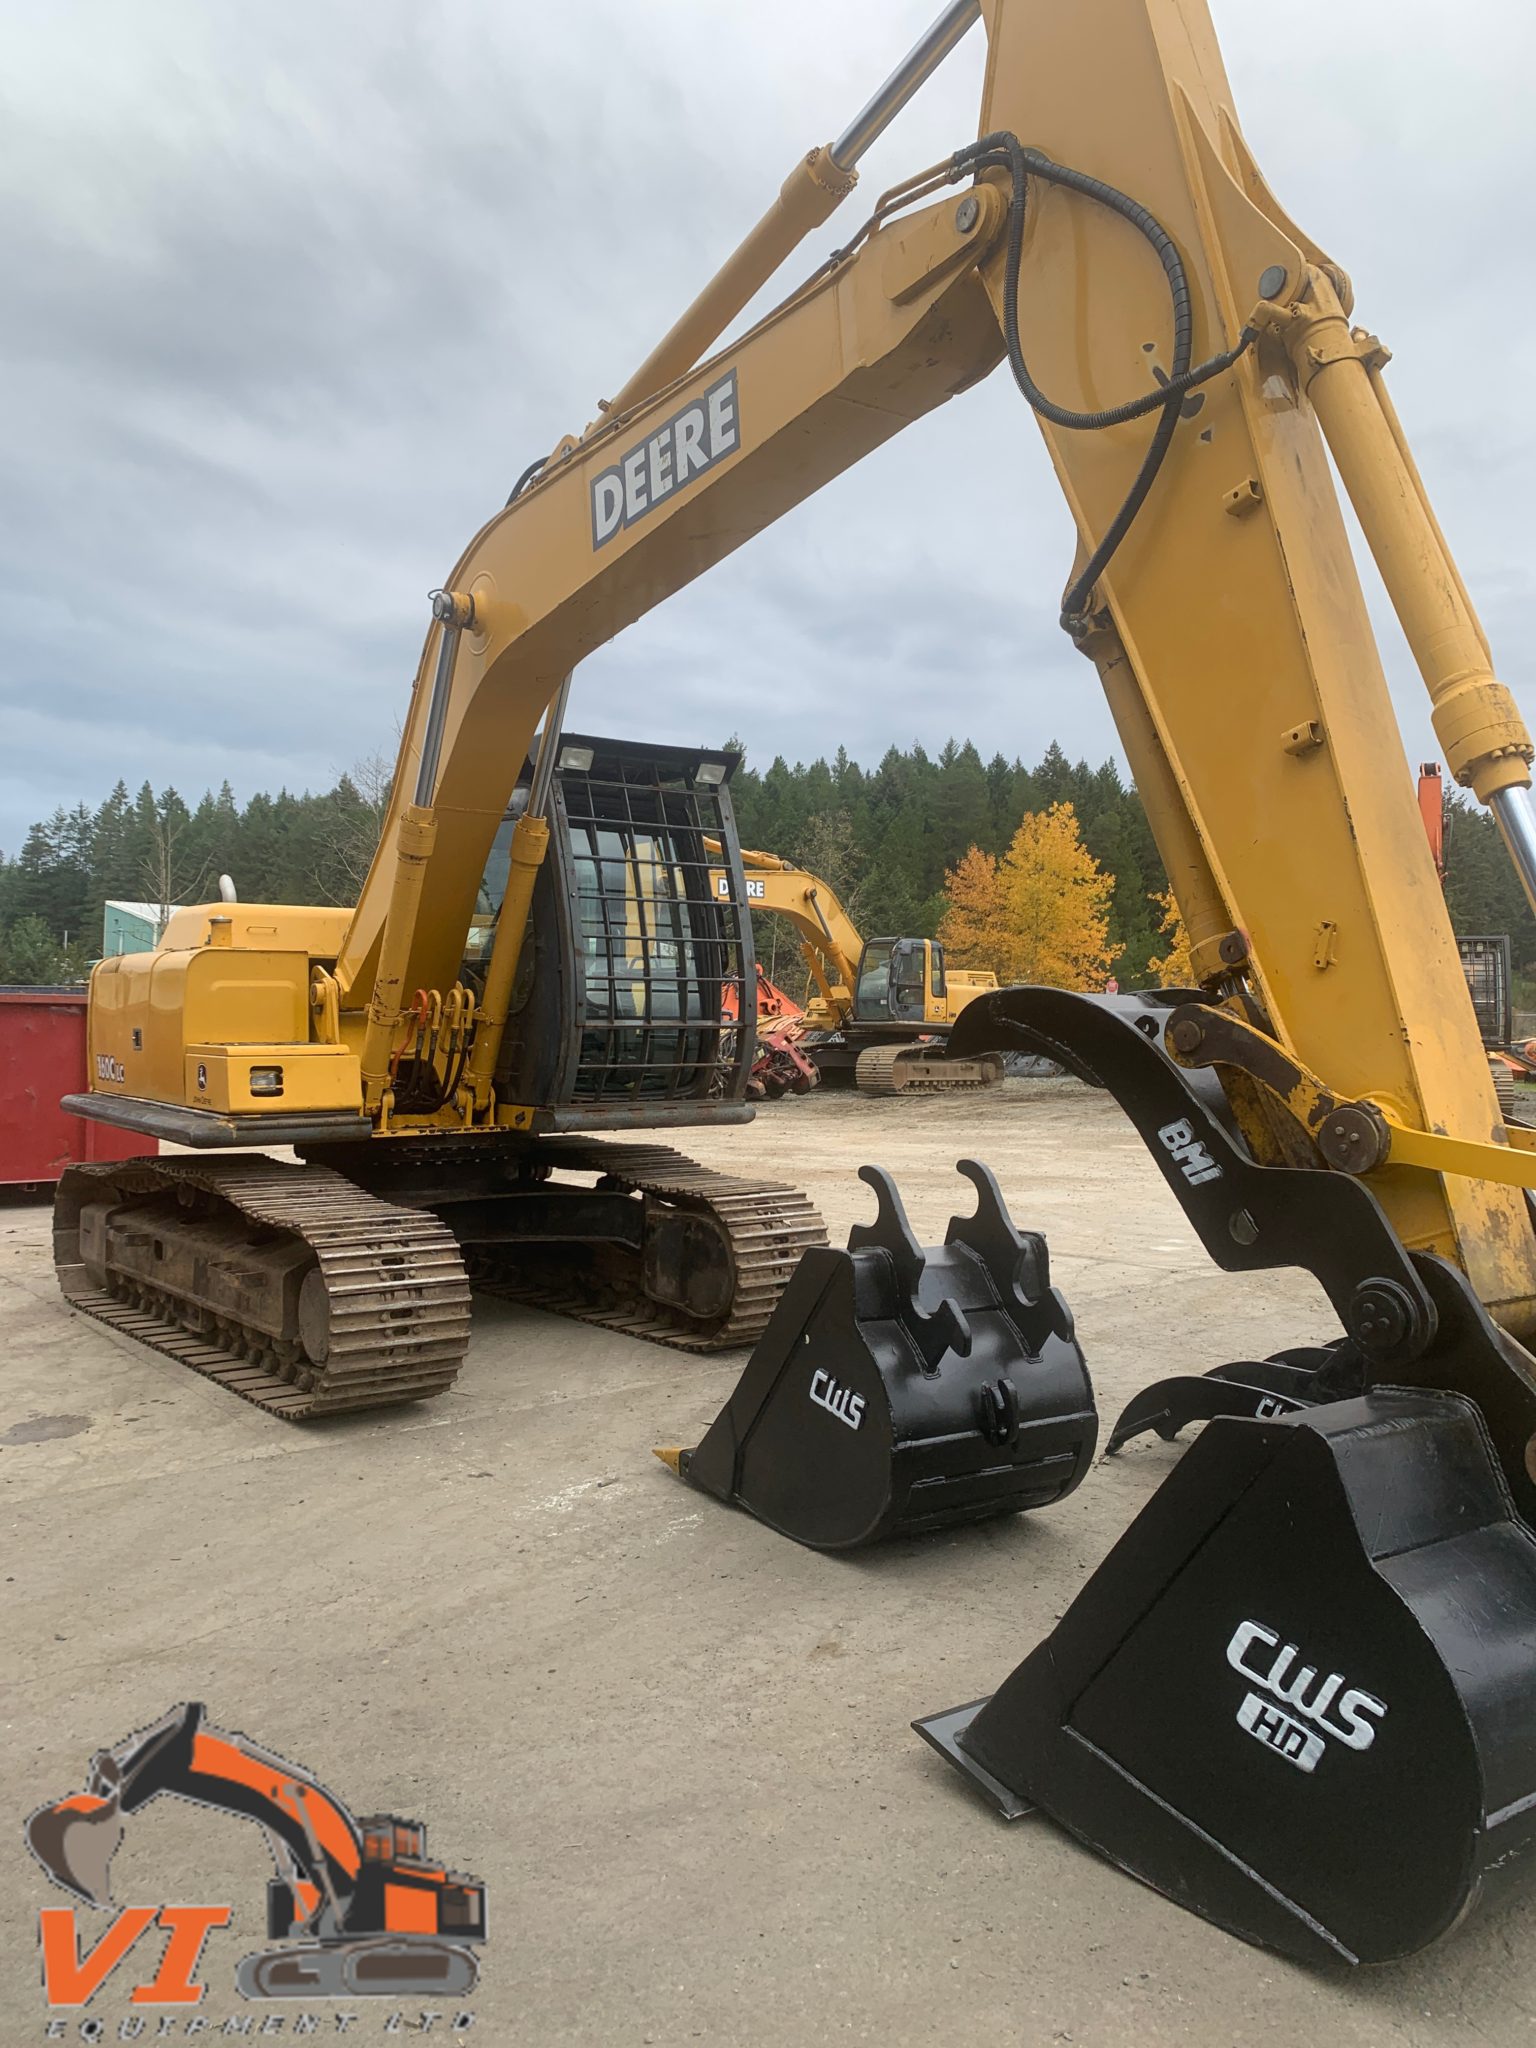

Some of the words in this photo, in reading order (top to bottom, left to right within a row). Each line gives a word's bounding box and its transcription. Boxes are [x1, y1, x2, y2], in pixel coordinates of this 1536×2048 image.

[594, 377, 738, 543] DEERE
[718, 878, 764, 897] DRE
[1158, 1118, 1222, 1186] BMI
[809, 1368, 867, 1431] CWS
[1226, 1619, 1387, 1751] CWS
[1247, 1701, 1312, 1764] HD
